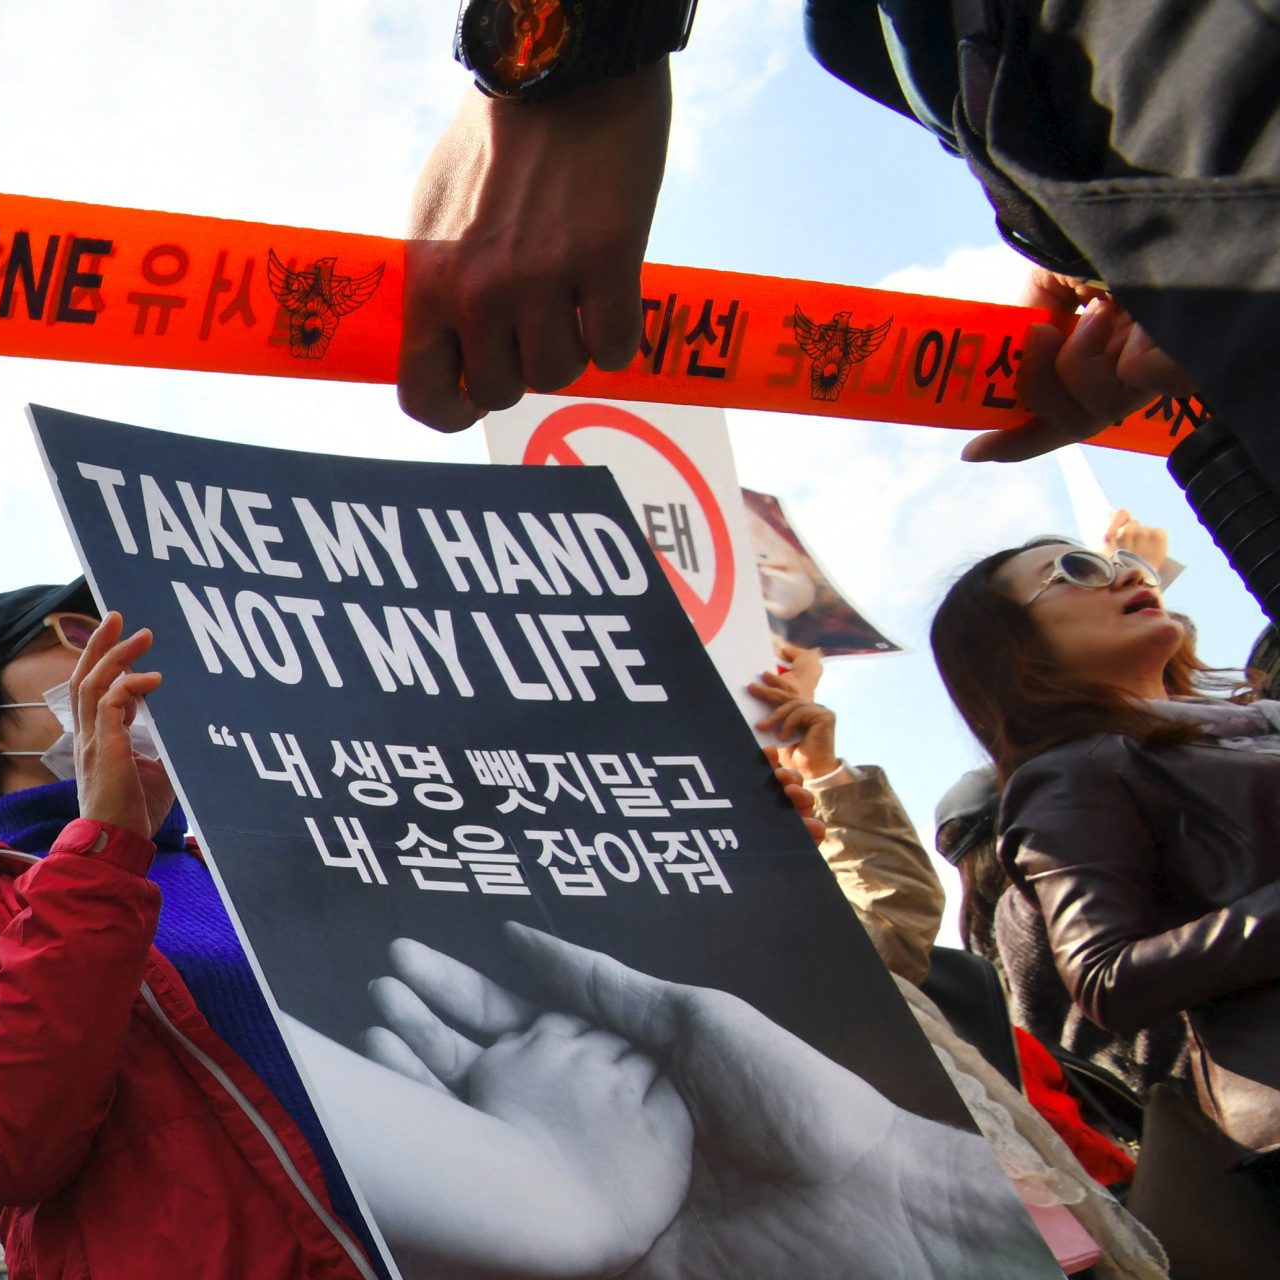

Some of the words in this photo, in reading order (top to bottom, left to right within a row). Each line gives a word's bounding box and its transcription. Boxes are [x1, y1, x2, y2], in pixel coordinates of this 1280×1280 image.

[914, 328, 961, 404] 이
[76, 461, 303, 579] TAKE
[291, 497, 419, 589] MY
[417, 508, 649, 596] HAND
[643, 503, 700, 573] 태
[171, 581, 343, 688] NOT
[342, 602, 475, 698] MY
[470, 611, 668, 702] LIFE
[330, 739, 464, 811] 생명
[464, 749, 733, 817] 뺏지말고
[304, 816, 388, 885] 내
[395, 823, 532, 896] 손을
